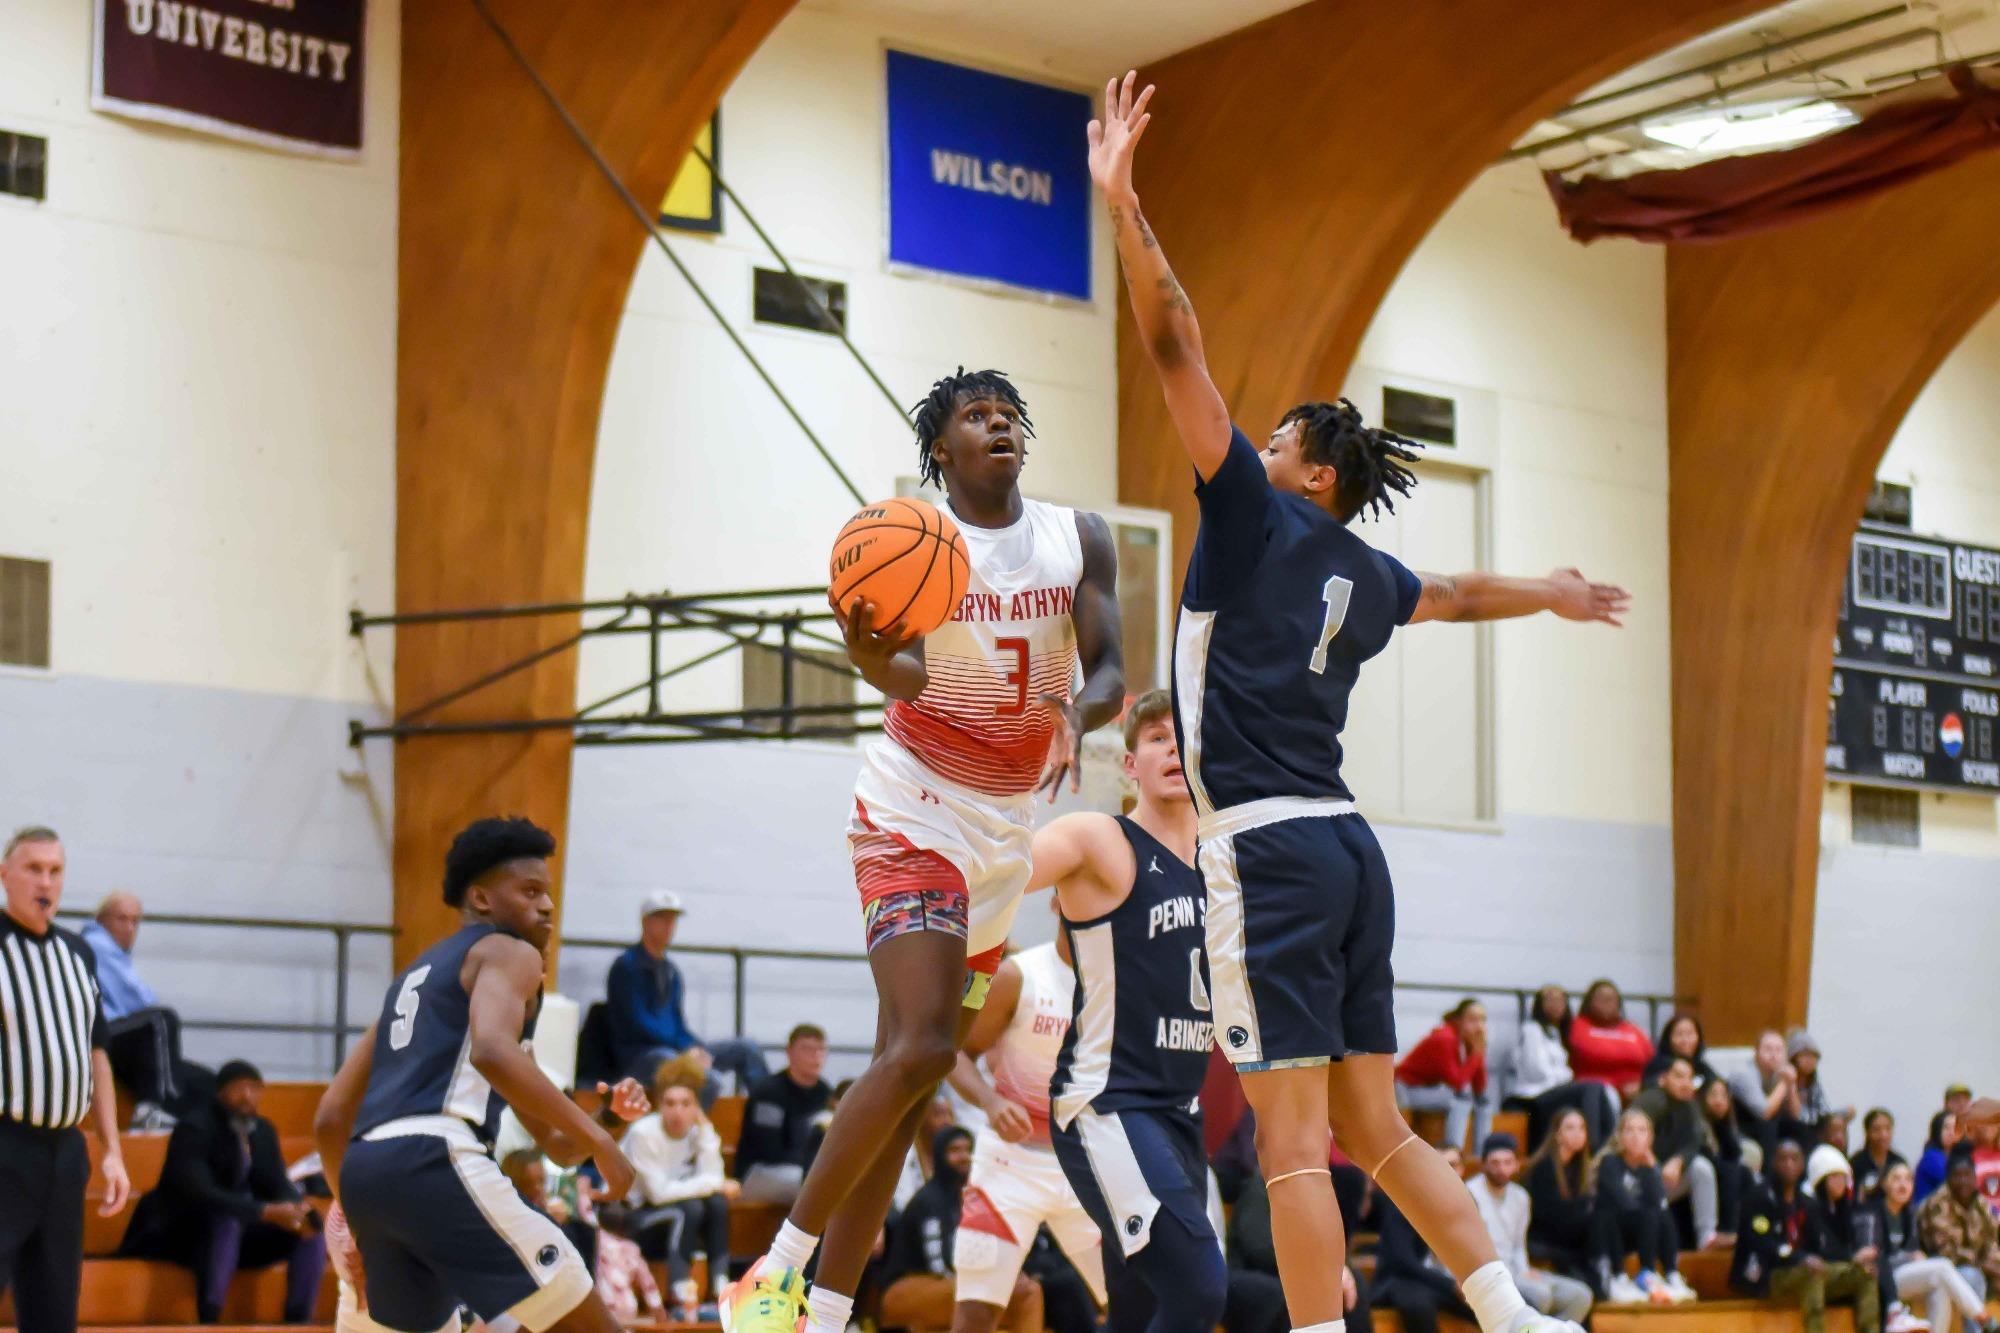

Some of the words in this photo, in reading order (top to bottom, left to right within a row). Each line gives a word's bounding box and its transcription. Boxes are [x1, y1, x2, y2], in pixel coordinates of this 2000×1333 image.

[125, 0, 351, 82] UNIVERSITY
[931, 149, 1053, 207] WILSON
[1953, 546, 2000, 585] GUEST
[1010, 585, 1072, 621] ATHYN
[1309, 575, 1354, 675] 1
[992, 636, 1031, 717] 3
[1879, 678, 1928, 708] PLAYER
[1148, 895, 1196, 941] PENN
[389, 962, 432, 1051] 5
